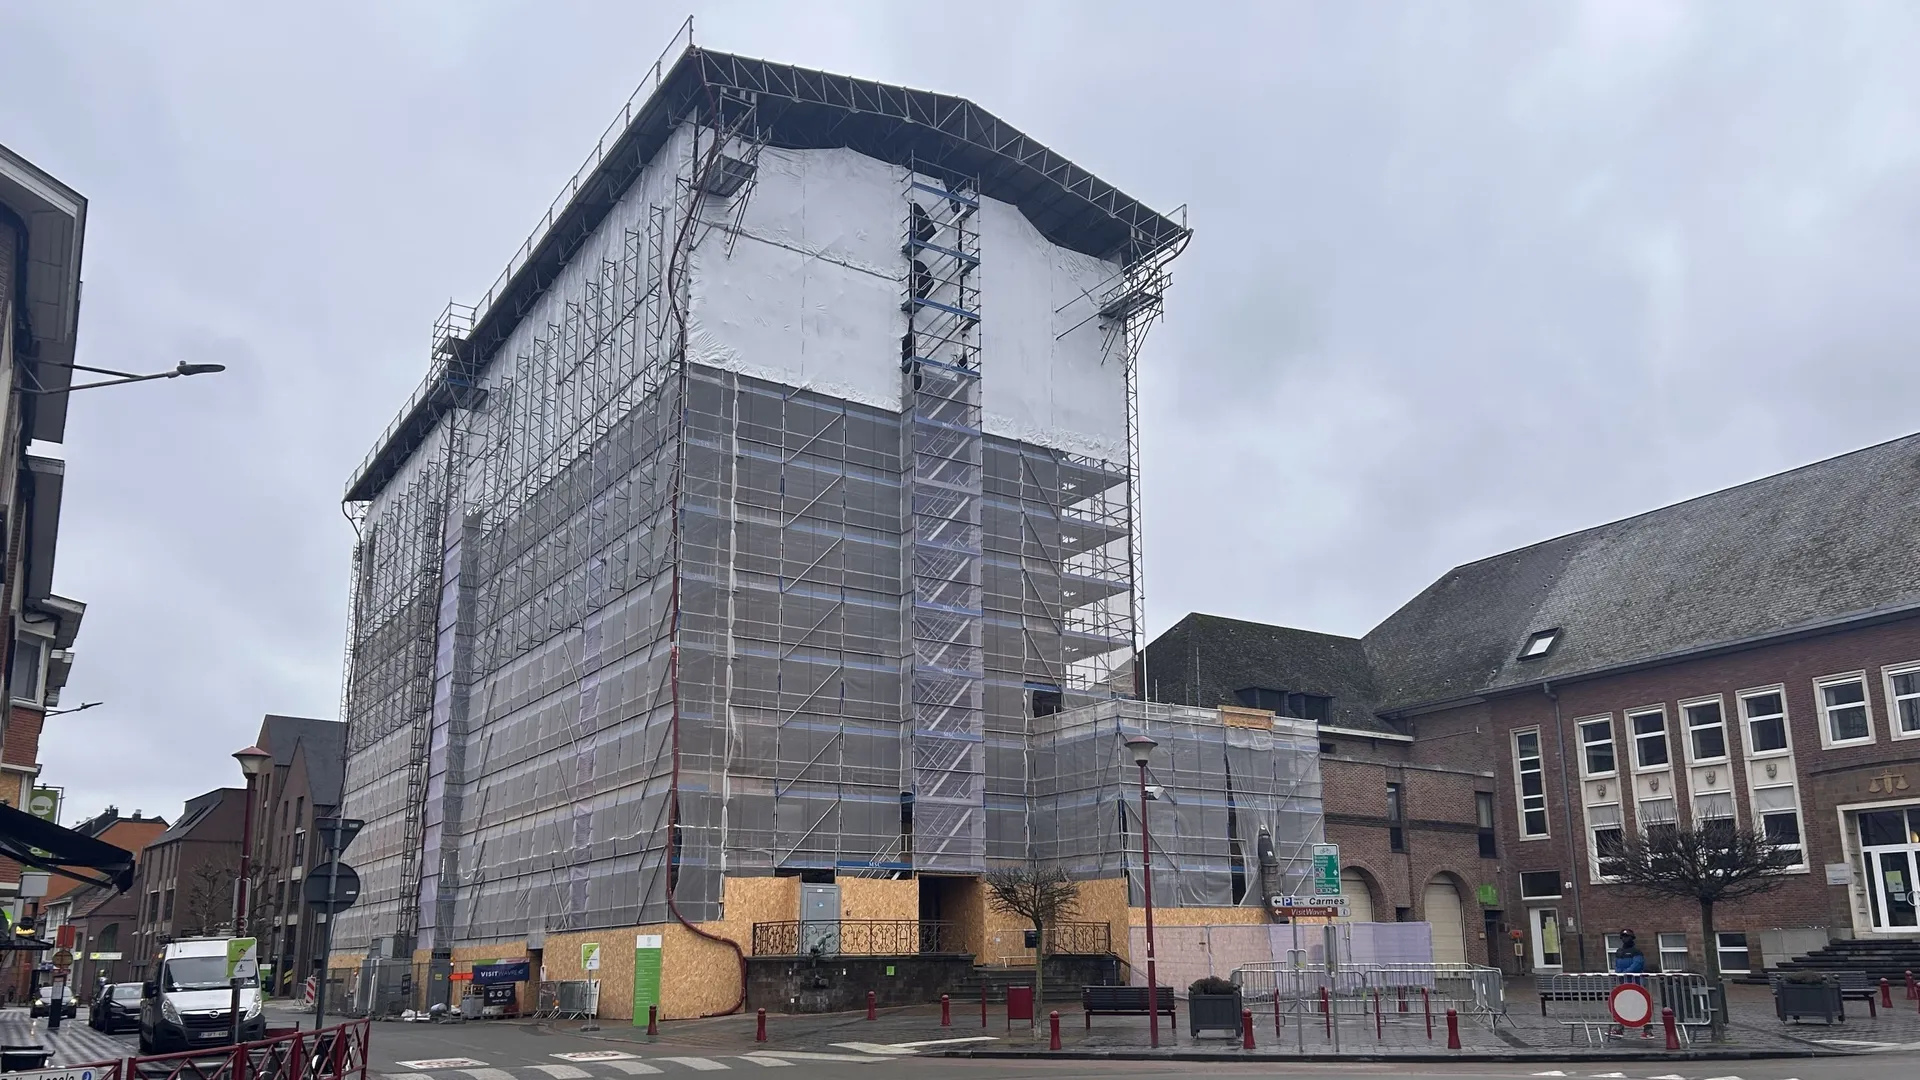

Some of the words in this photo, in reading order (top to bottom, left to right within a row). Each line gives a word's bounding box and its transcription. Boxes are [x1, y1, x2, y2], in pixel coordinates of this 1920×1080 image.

[1284, 898, 1291, 906] P
[1309, 897, 1345, 905] Carmes
[1291, 908, 1327, 916] VisitWavre
